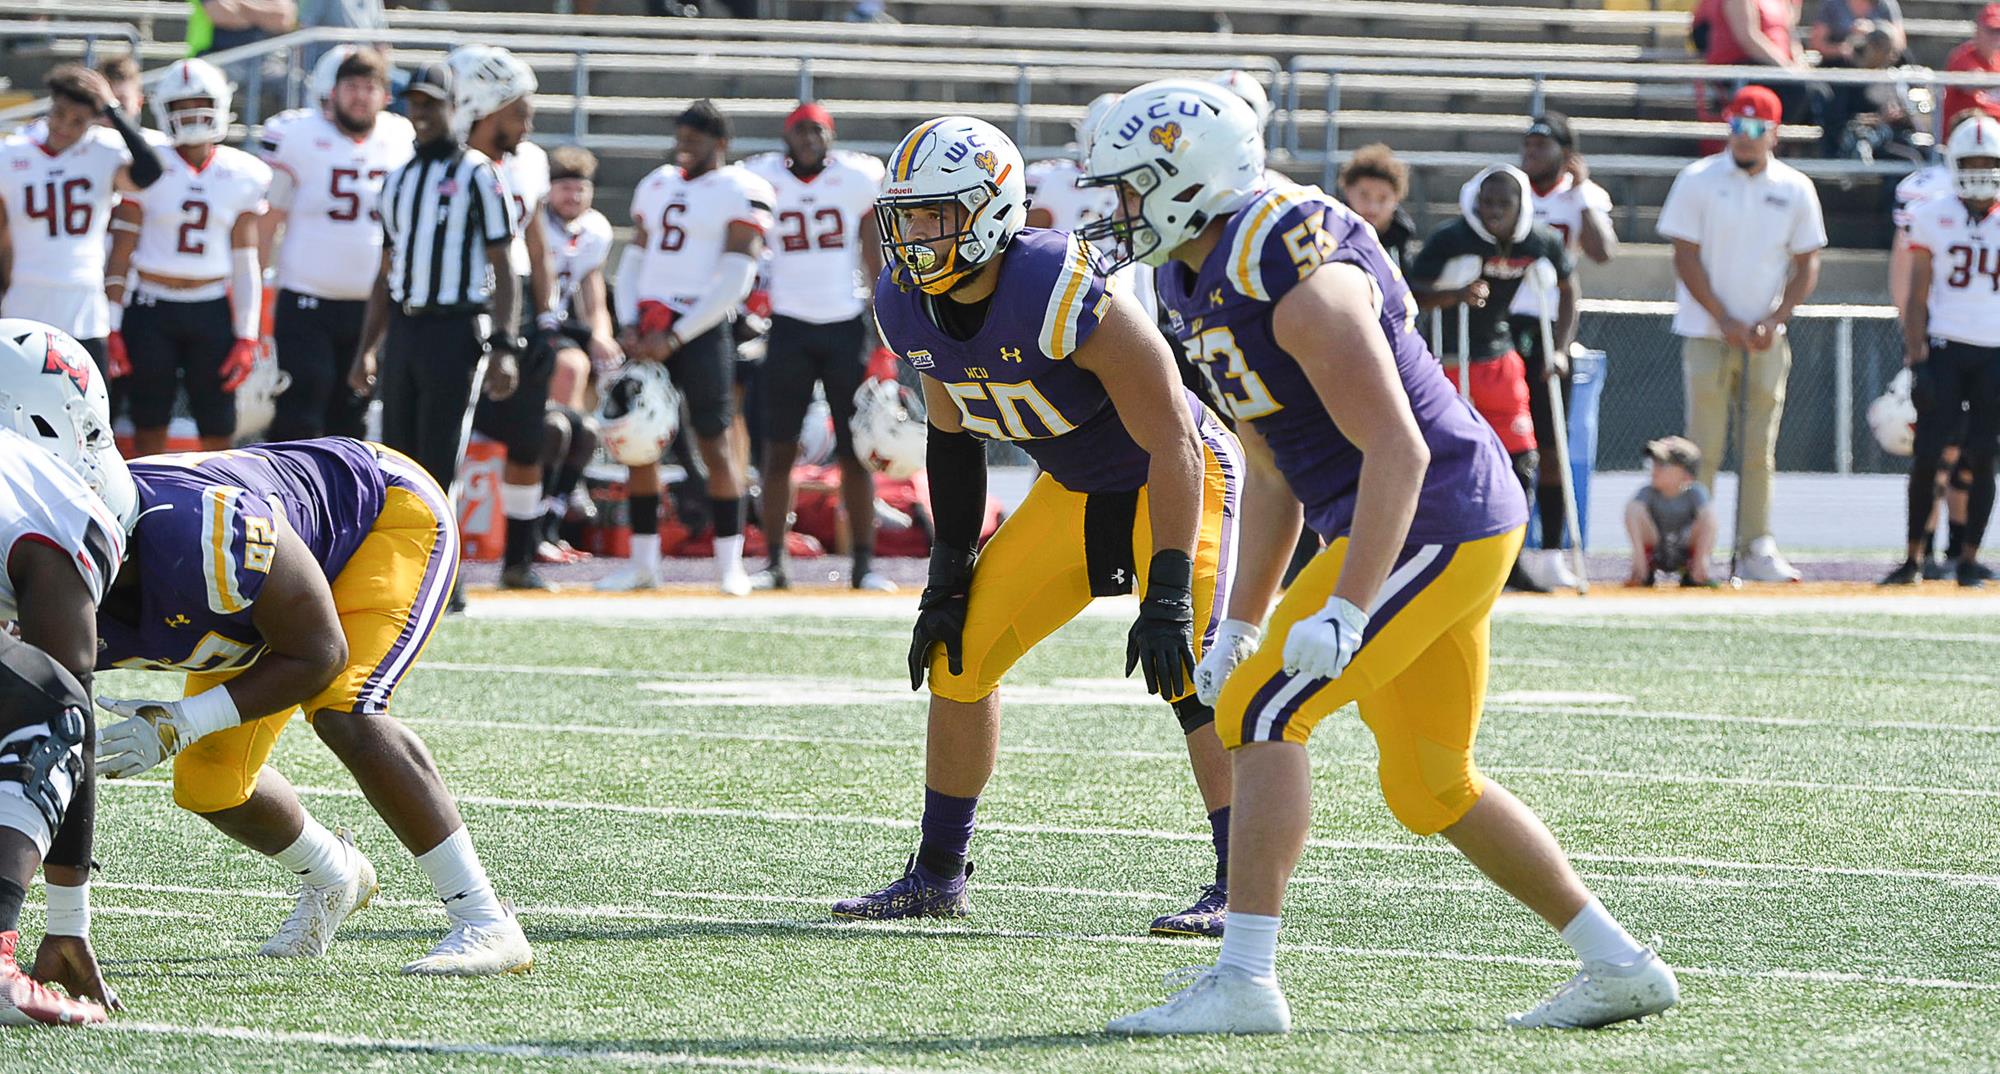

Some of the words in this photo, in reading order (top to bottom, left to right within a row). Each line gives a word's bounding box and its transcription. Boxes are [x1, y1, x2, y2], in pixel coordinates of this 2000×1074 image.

[1119, 101, 1200, 141] WCU
[25, 177, 92, 237] 46
[177, 200, 208, 254] 2
[661, 203, 687, 251] 6
[779, 208, 843, 252] 22
[1947, 245, 2000, 292] 34
[964, 367, 989, 379] WCU
